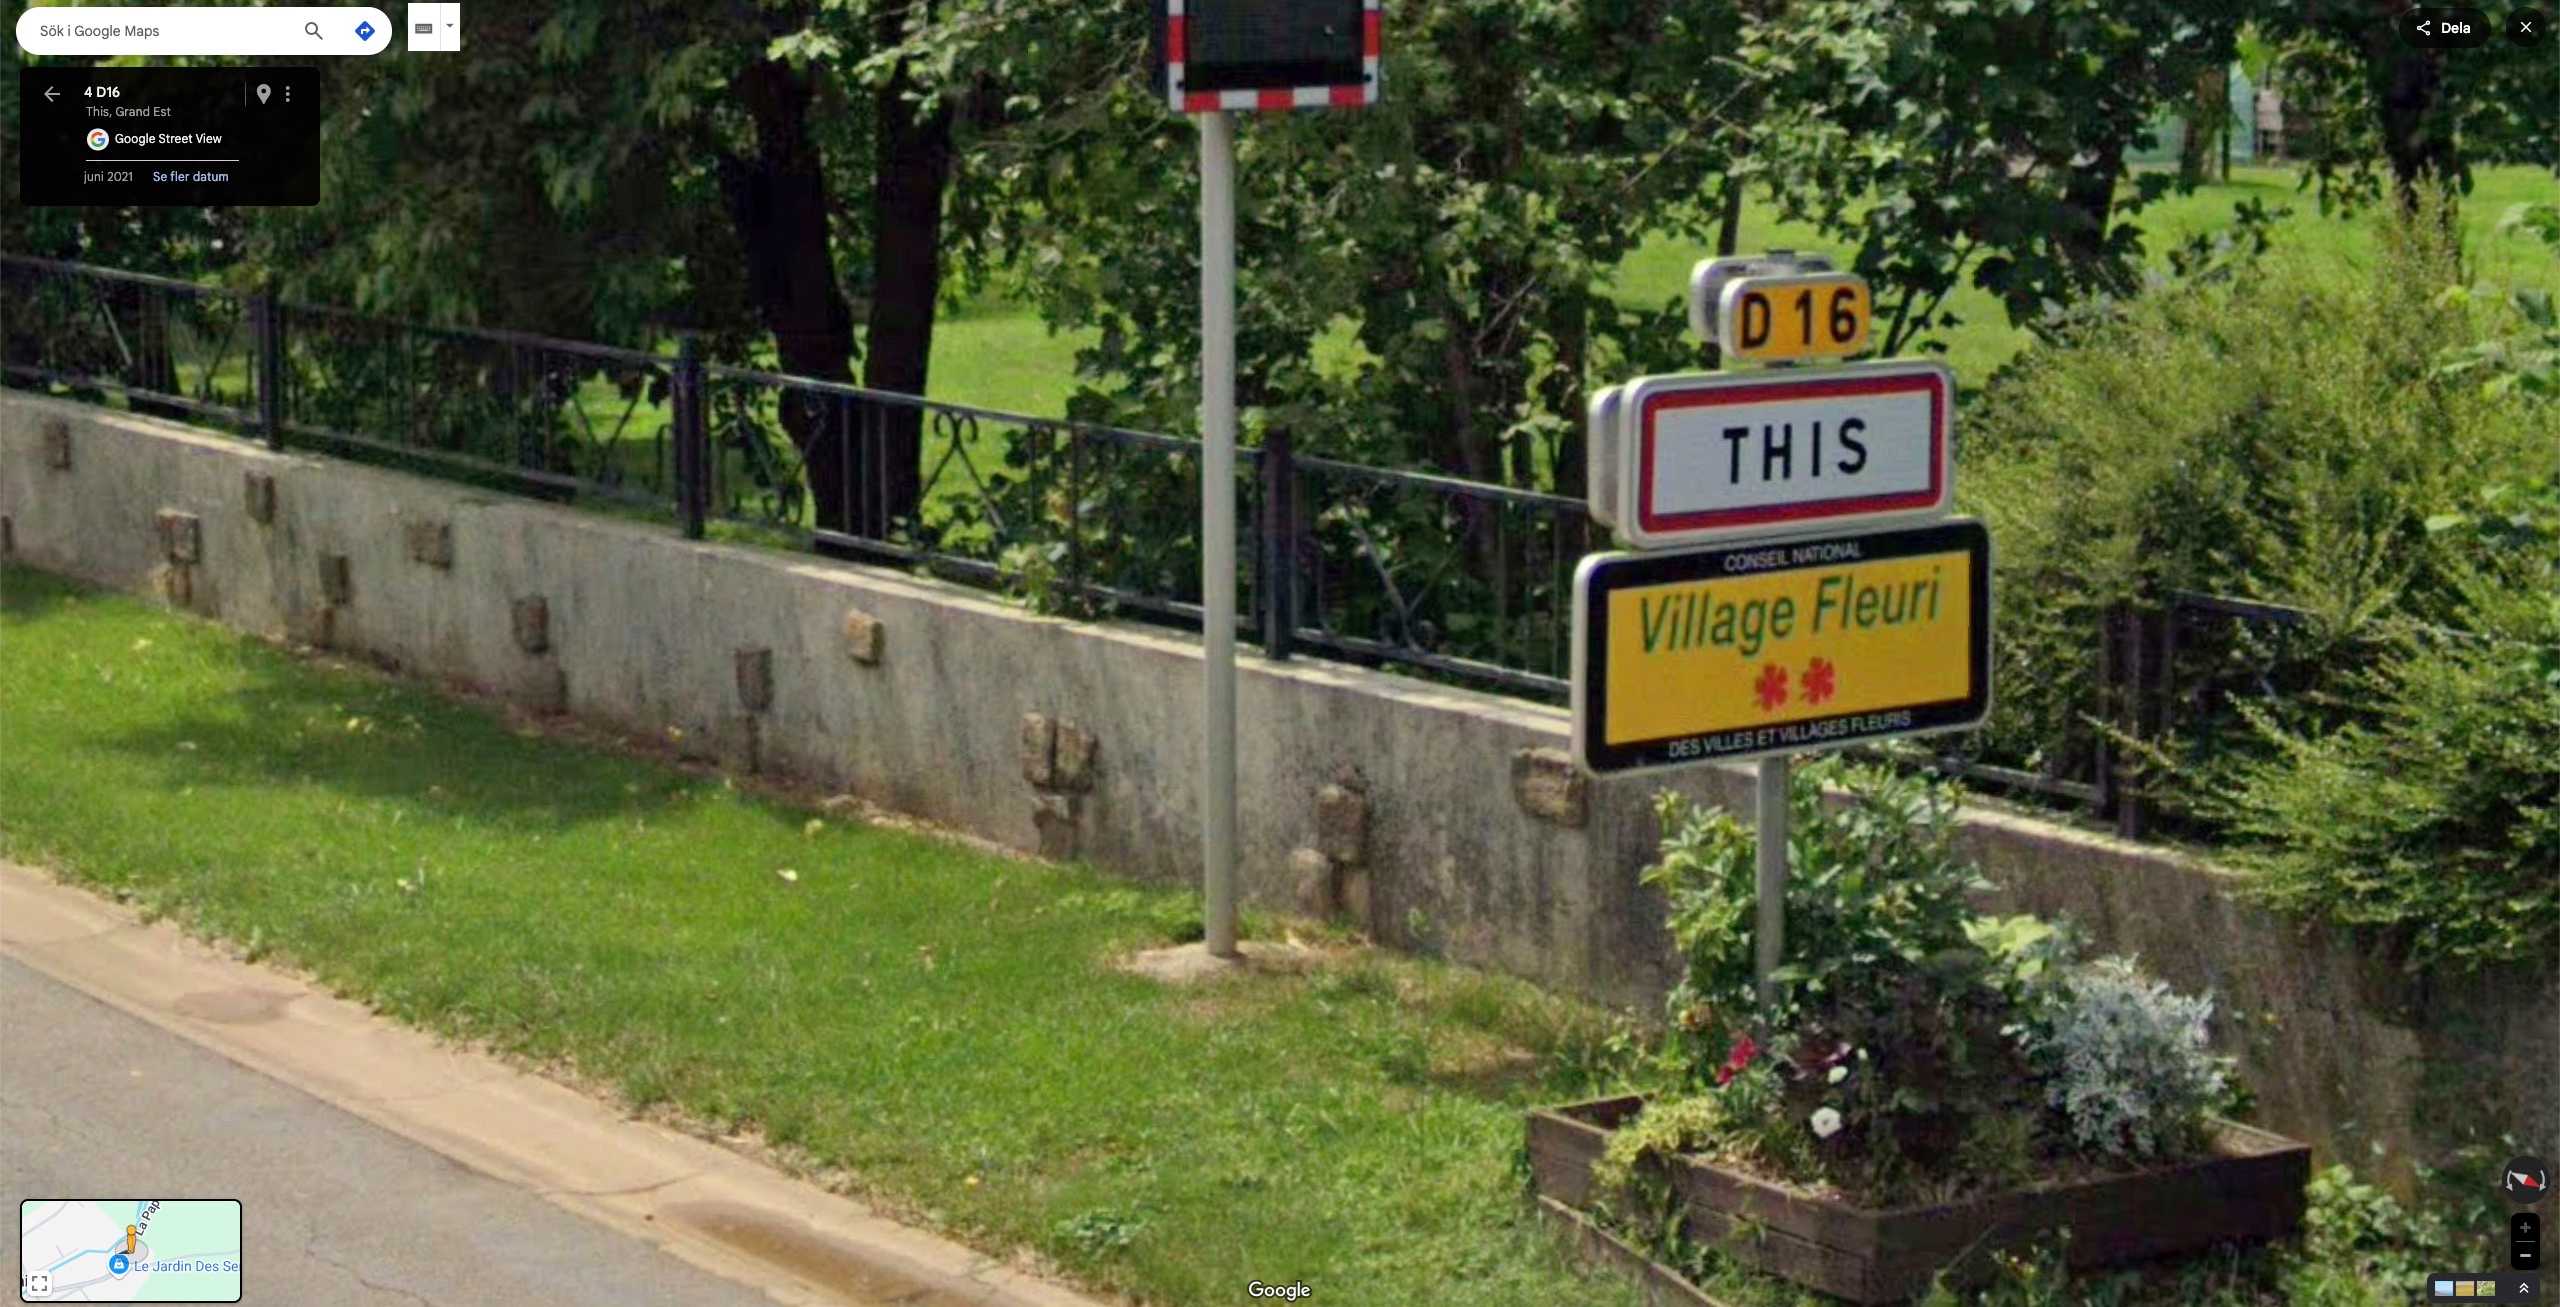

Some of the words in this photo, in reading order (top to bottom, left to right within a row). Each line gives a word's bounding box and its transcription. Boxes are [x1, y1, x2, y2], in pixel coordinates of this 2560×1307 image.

[1740, 292, 1771, 349] D
[1794, 287, 1857, 346] 16
[1722, 417, 1868, 484] THIS
[1723, 549, 1791, 572] CONSEIL
[1792, 542, 1861, 564] NATIONAL
[1640, 593, 1795, 656] Village
[1812, 566, 1940, 633] Fleuri
[1668, 739, 1701, 758] DES
[1703, 731, 1754, 752] VILLES
[1757, 729, 1777, 746] ET
[1777, 718, 1850, 743] VILLAGES
[1849, 710, 1912, 735] FLEURIS
